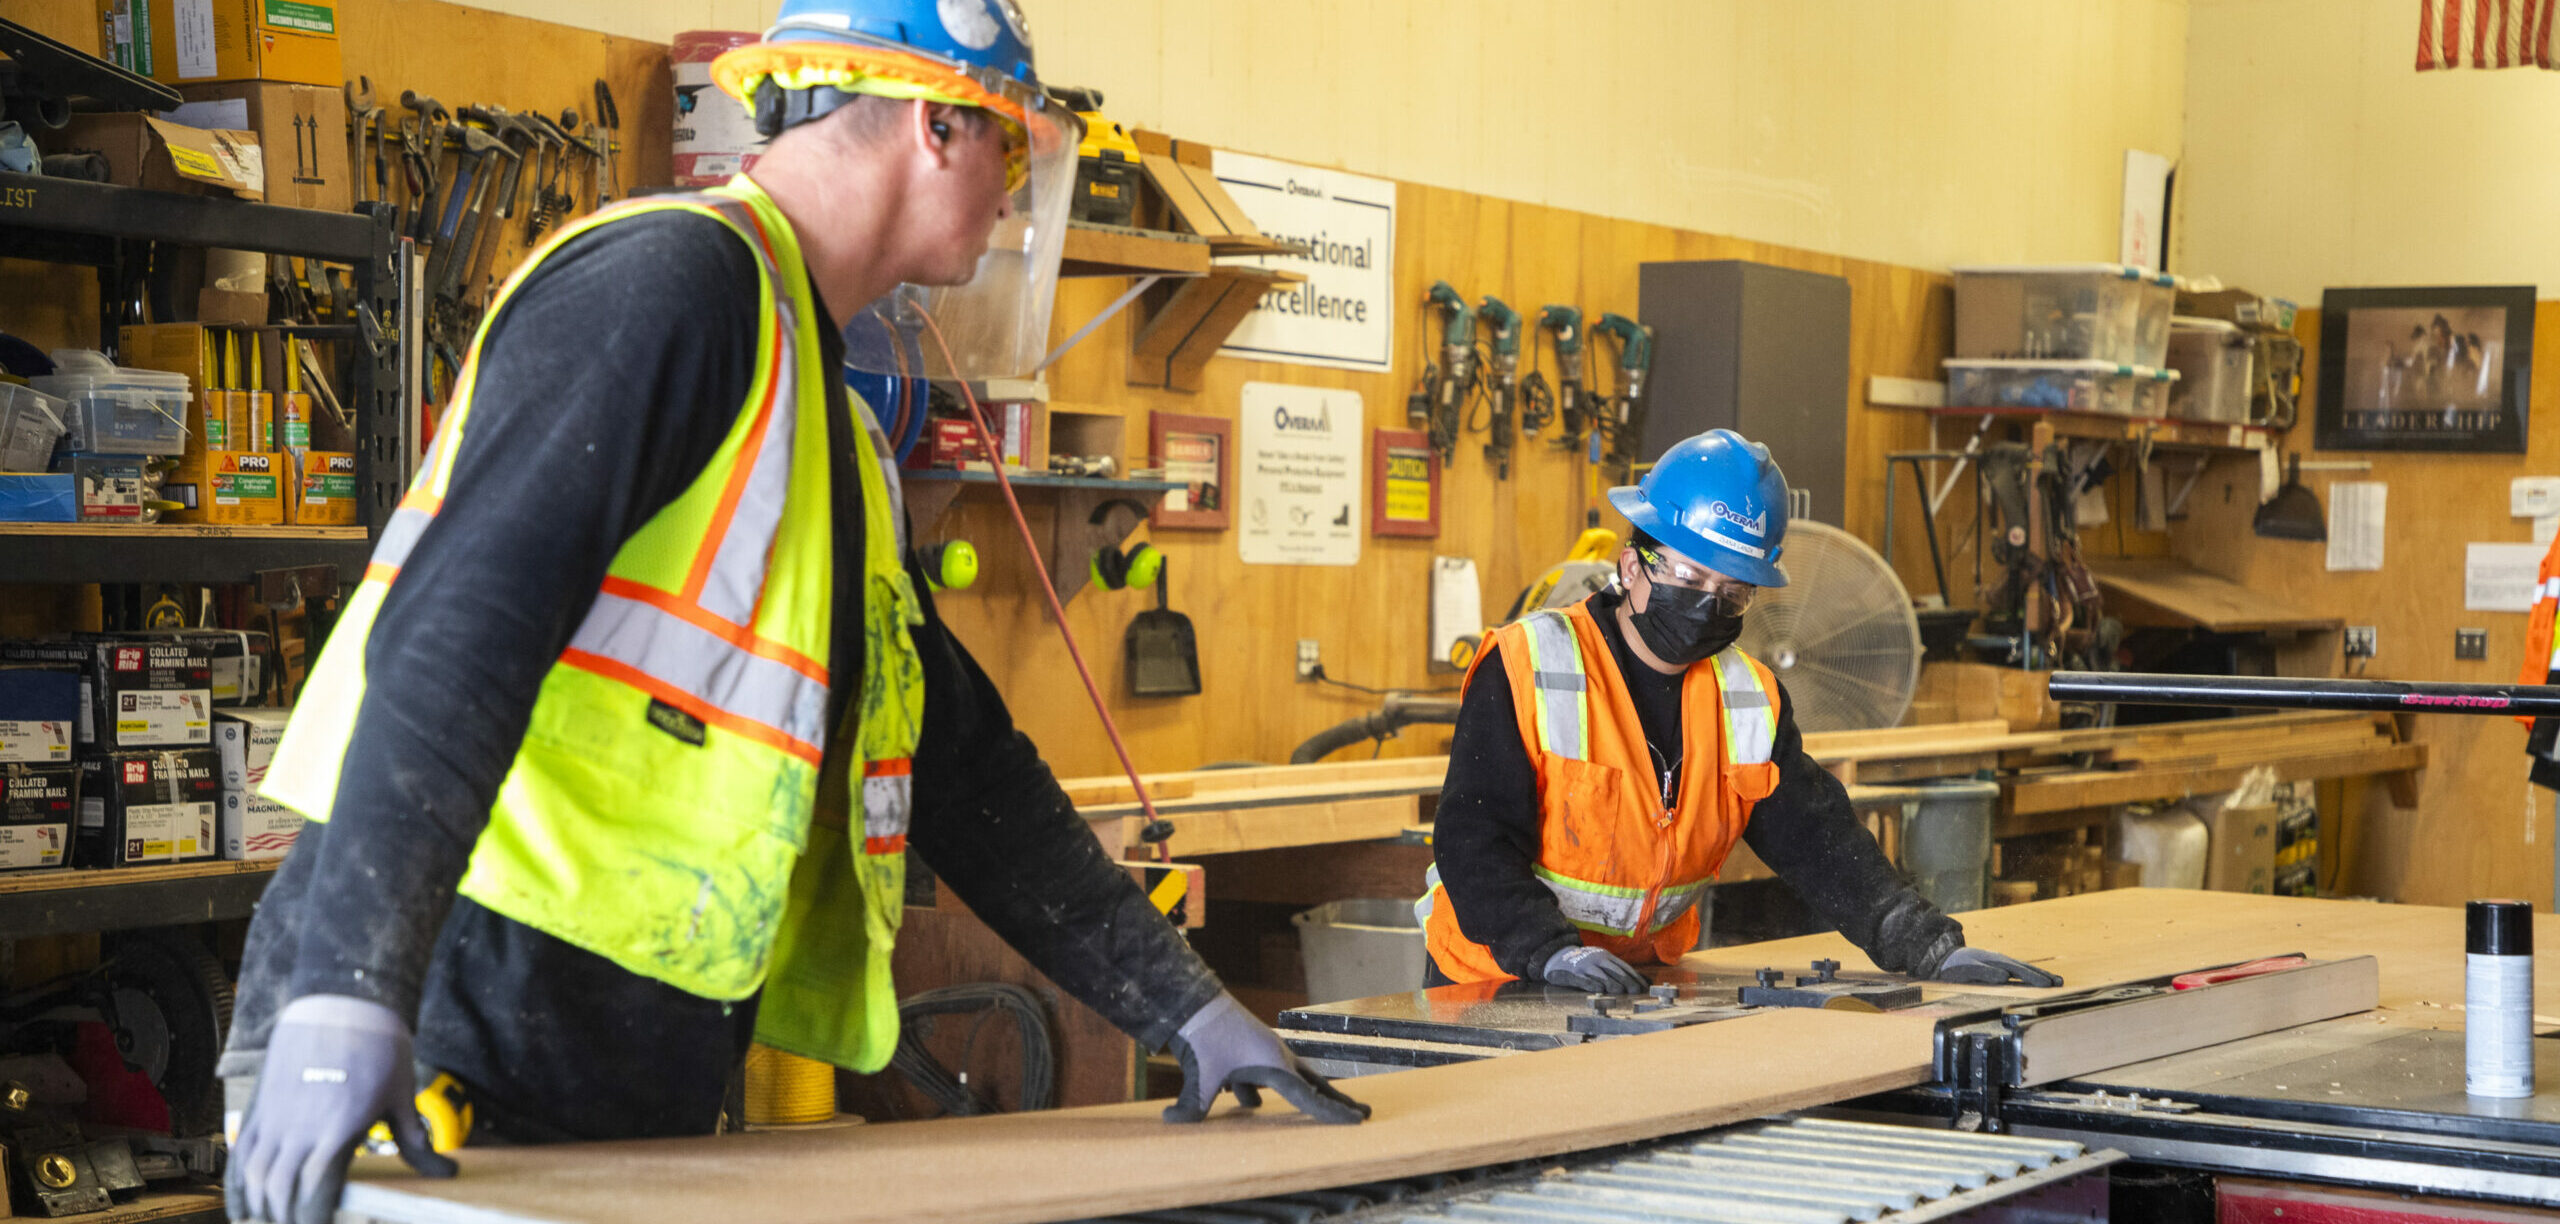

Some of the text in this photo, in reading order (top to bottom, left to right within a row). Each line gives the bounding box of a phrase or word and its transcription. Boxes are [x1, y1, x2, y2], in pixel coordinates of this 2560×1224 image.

[1257, 281, 1367, 322] xcellence
[2343, 411, 2502, 431] LEADERSHIP
[239, 456, 269, 467] PRO
[329, 457, 354, 468] PRO
[68, 650, 89, 660] NAILS
[118, 649, 142, 659] Grip
[149, 647, 188, 658] COLLATED
[117, 660, 139, 670] Rite
[149, 657, 208, 669] FRAMING NAILS
[125, 762, 145, 773] Grip
[188, 767, 210, 778] NAILS
[126, 774, 144, 783] Rite
[45, 787, 67, 798] NAILS
[247, 804, 286, 815] MAGNUM
